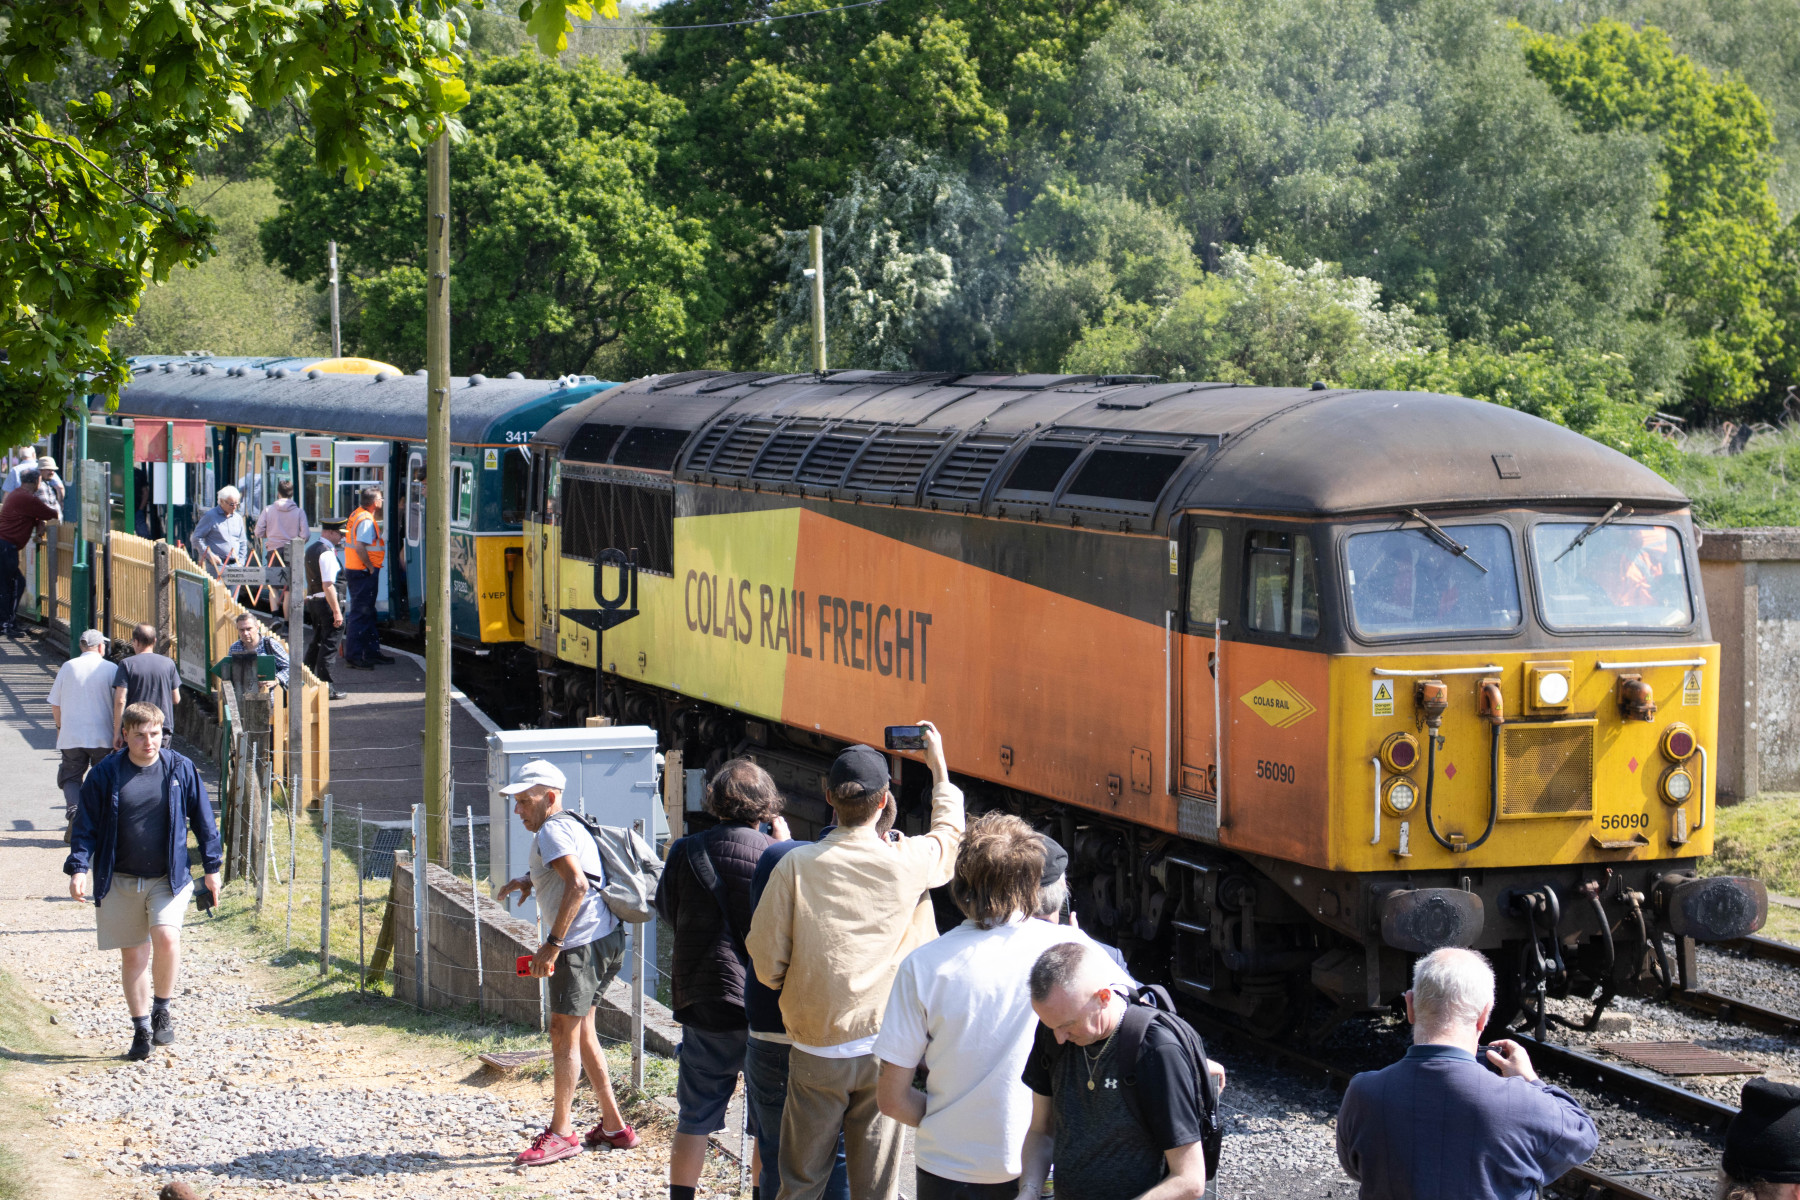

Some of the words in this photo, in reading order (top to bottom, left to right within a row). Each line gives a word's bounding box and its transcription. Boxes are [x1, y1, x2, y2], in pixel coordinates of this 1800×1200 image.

[505, 431, 537, 443] 3417
[481, 592, 487, 600] 4
[488, 591, 506, 600] VEP
[685, 569, 753, 645] COLAS
[759, 583, 813, 659] RAIL
[818, 594, 933, 684] FREIGHT
[1253, 695, 1275, 708] COLAS
[1275, 698, 1290, 710] RAIL
[1257, 759, 1295, 784] 56090
[1601, 813, 1649, 829] 56090
